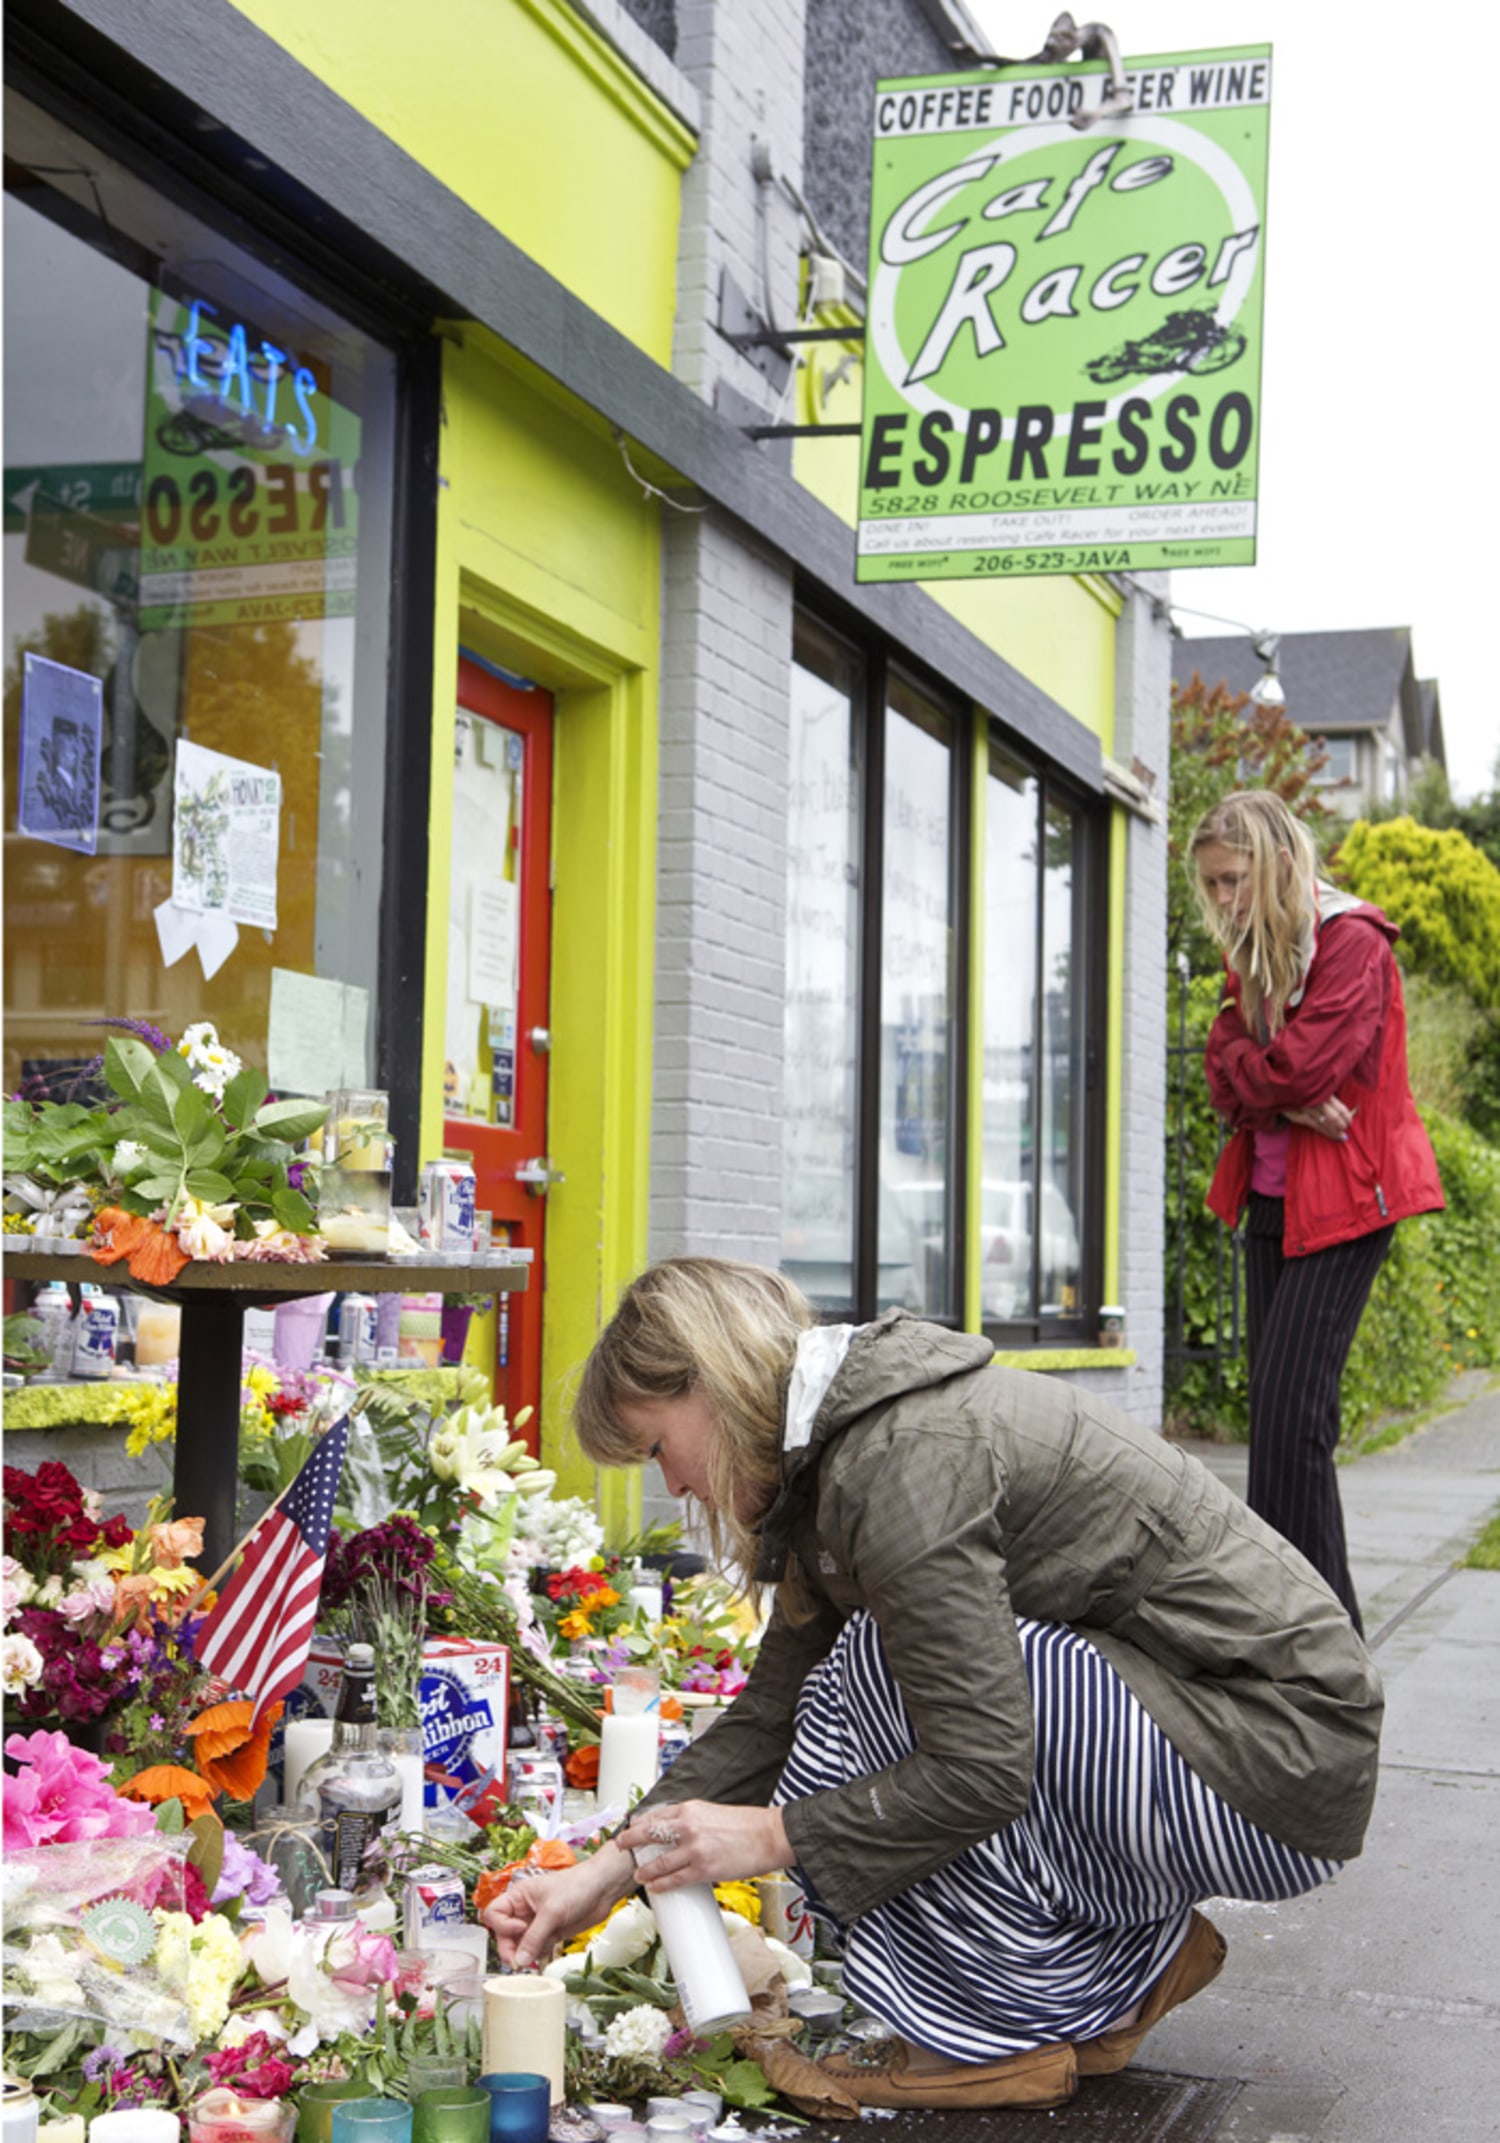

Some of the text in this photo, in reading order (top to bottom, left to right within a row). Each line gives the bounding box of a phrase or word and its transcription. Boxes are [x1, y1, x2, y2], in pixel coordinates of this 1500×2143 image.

[878, 87, 993, 132] COFFEE
[1009, 78, 1084, 121] FOOD
[1189, 63, 1267, 105] WINE
[880, 140, 1174, 266] Cafe
[902, 224, 1260, 387] Racer
[181, 298, 319, 456] EATS
[864, 390, 1254, 490] ESPRESSO
[868, 477, 1251, 515] 5828 ROOSEVELT WAY NE
[1128, 508, 1184, 522] ORDER
[991, 515, 1029, 528] TAKE
[973, 549, 1132, 573] 206-523-JAVA
[318, 1668, 340, 1688] 24
[474, 1656, 502, 1675] 24
